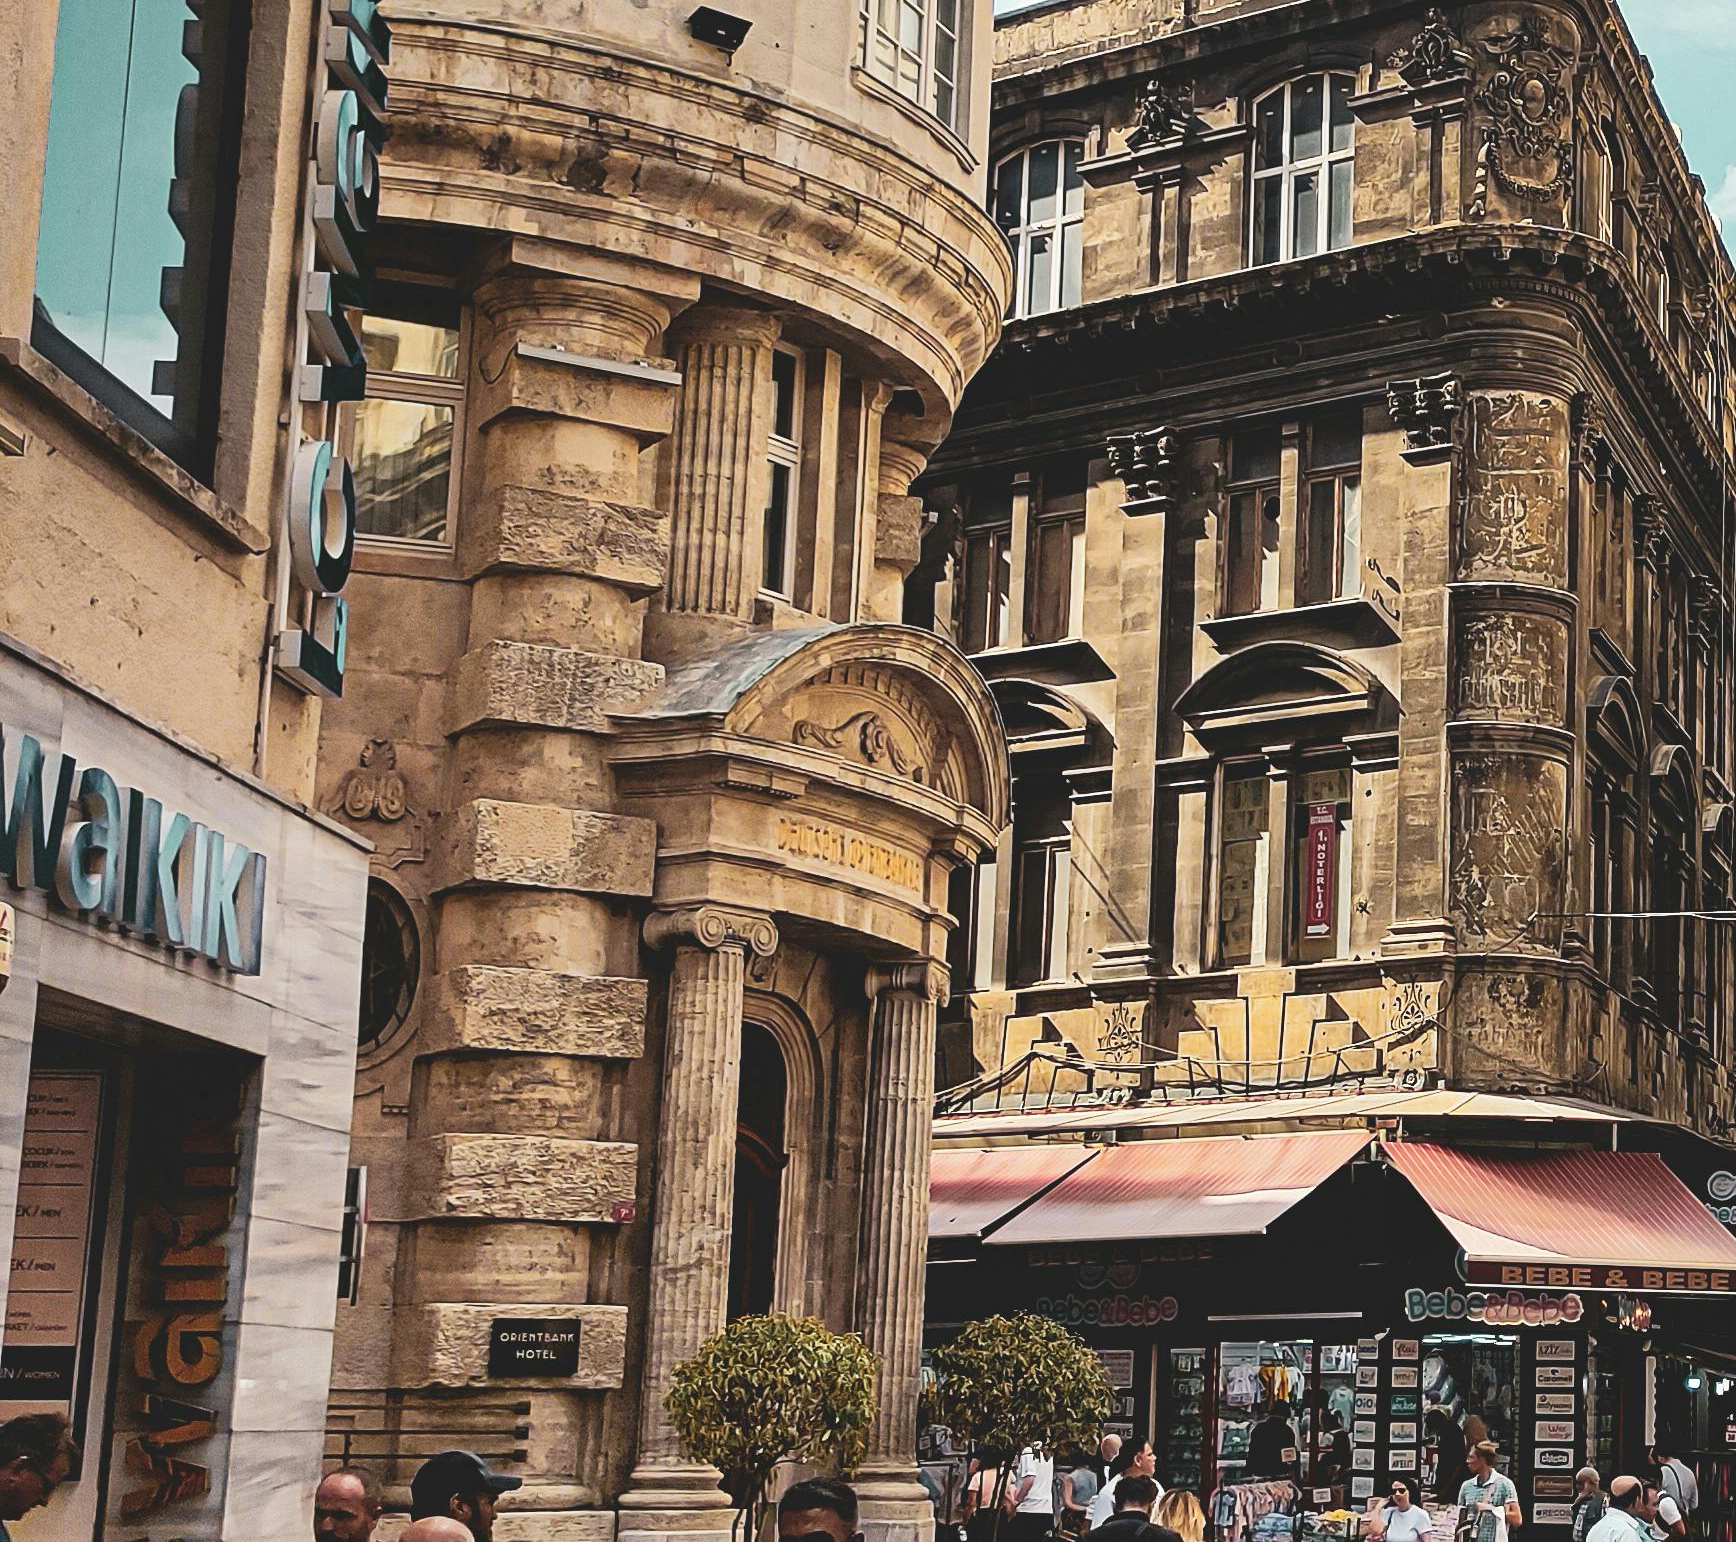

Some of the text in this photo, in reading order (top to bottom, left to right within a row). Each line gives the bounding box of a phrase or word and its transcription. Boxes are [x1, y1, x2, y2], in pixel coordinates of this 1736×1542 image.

[1501, 1265, 1730, 1291] BEBE & BEBE
[499, 1332, 575, 1343] ORIENTBANK
[516, 1349, 557, 1359] HOTEL
